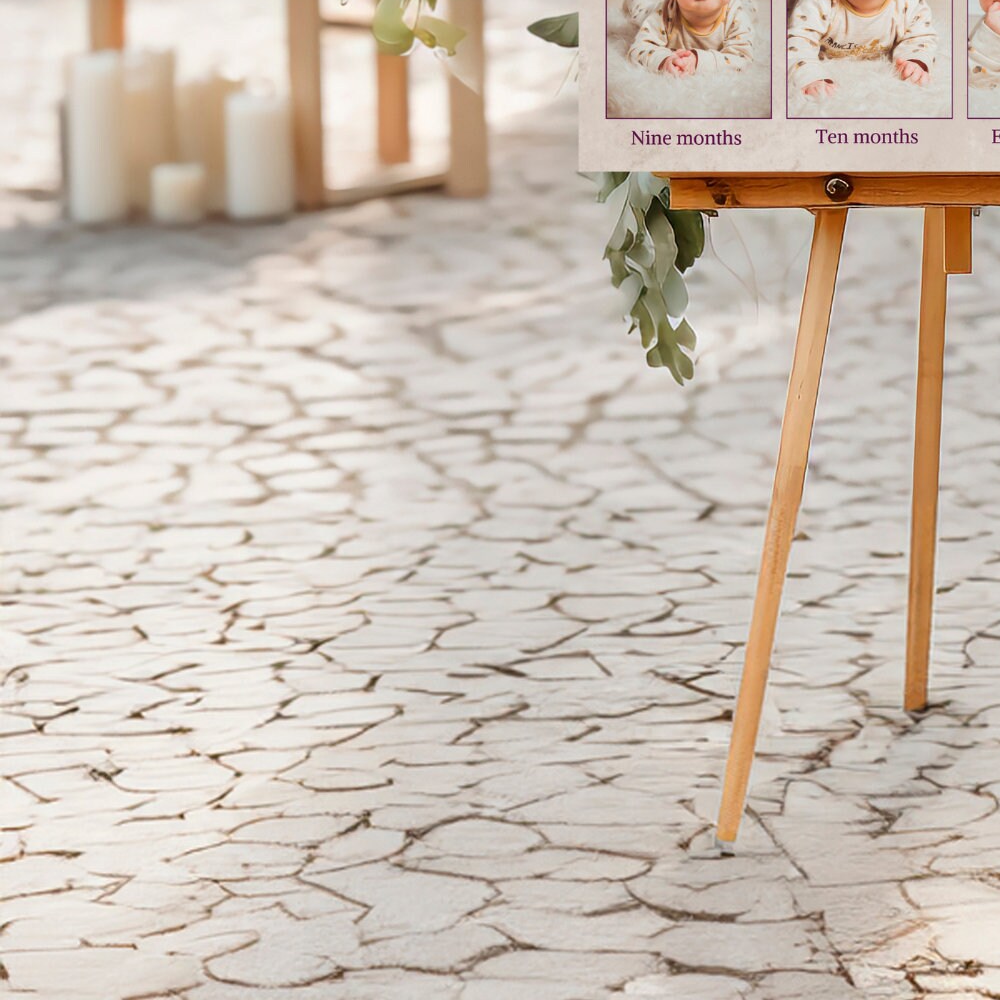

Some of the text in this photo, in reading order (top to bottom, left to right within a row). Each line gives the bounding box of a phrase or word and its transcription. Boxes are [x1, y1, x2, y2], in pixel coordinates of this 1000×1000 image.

[631, 129, 742, 146] Nine months
[815, 128, 919, 145] Ten months
